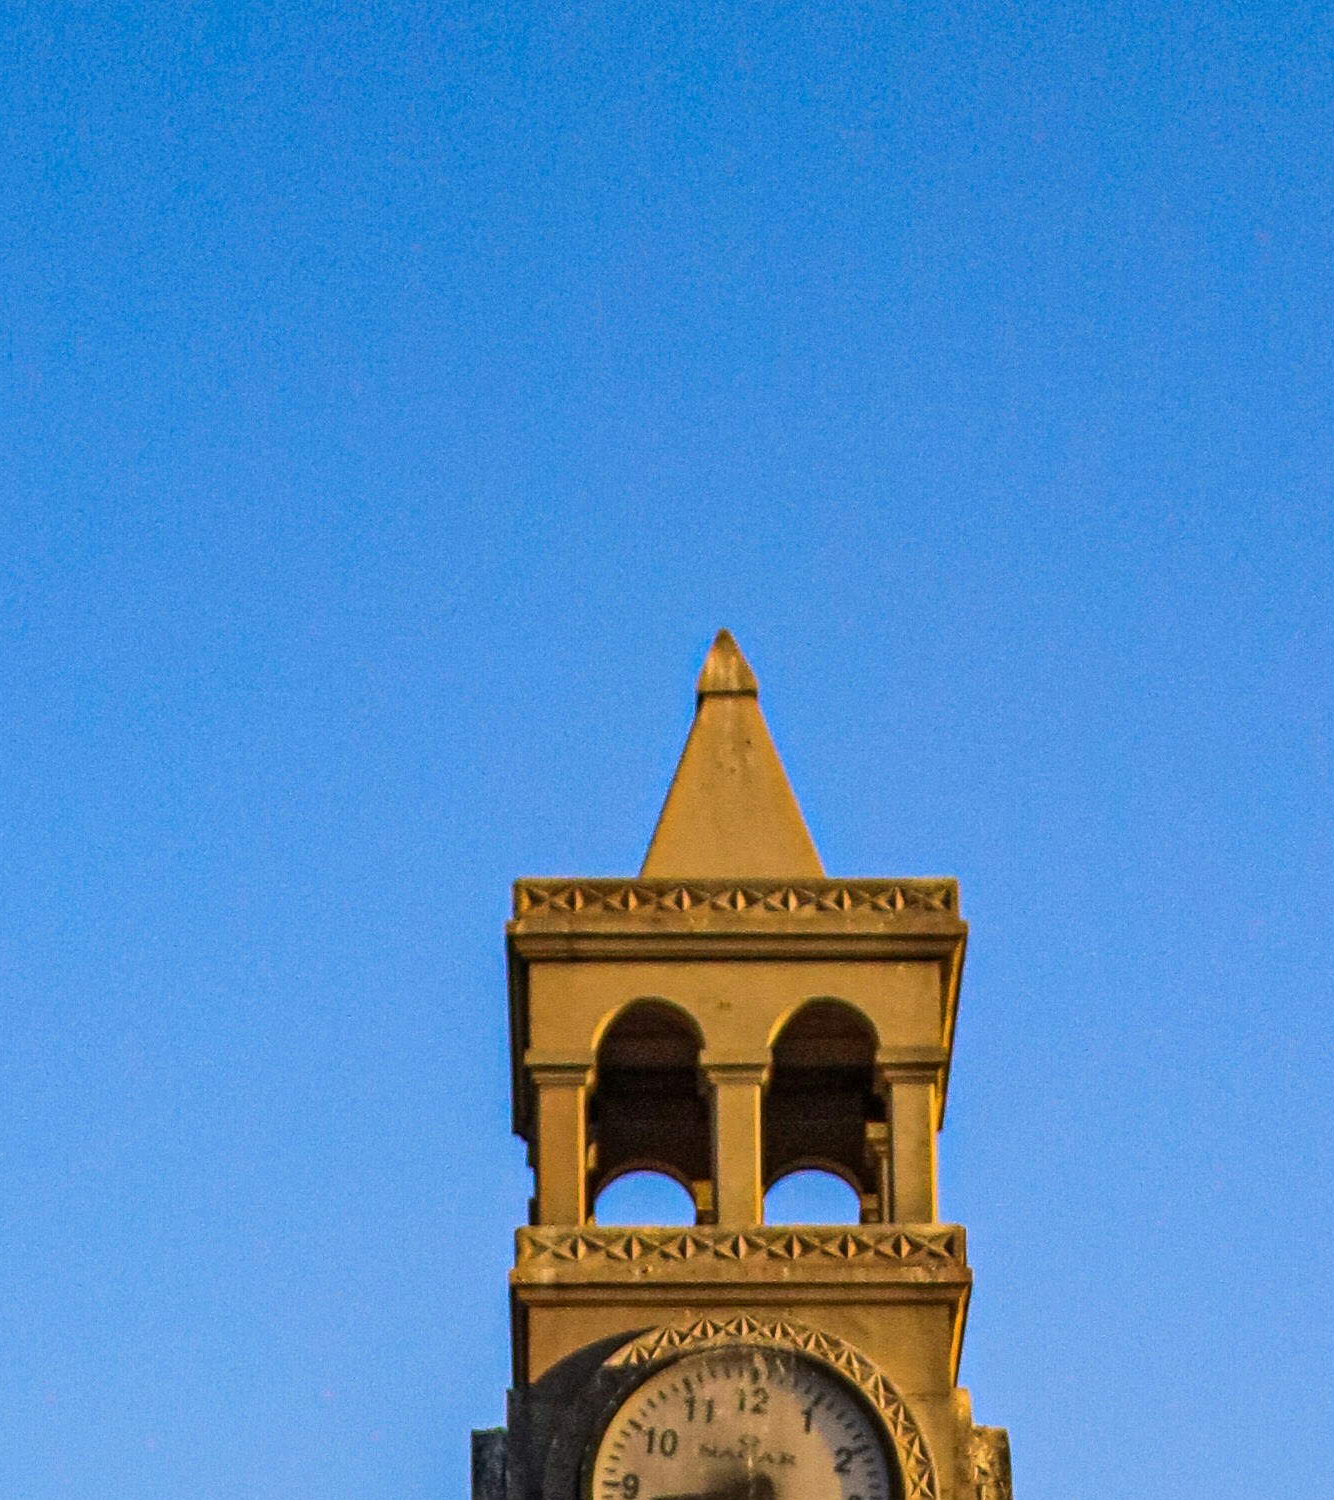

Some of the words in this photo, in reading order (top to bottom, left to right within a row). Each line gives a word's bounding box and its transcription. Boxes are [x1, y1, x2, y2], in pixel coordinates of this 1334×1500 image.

[683, 1397, 715, 1424] 11
[738, 1387, 769, 1415] 12
[801, 1408, 814, 1434] 1
[644, 1427, 679, 1457] 10
[834, 1446, 854, 1474] 2
[622, 1474, 640, 1500] 9
